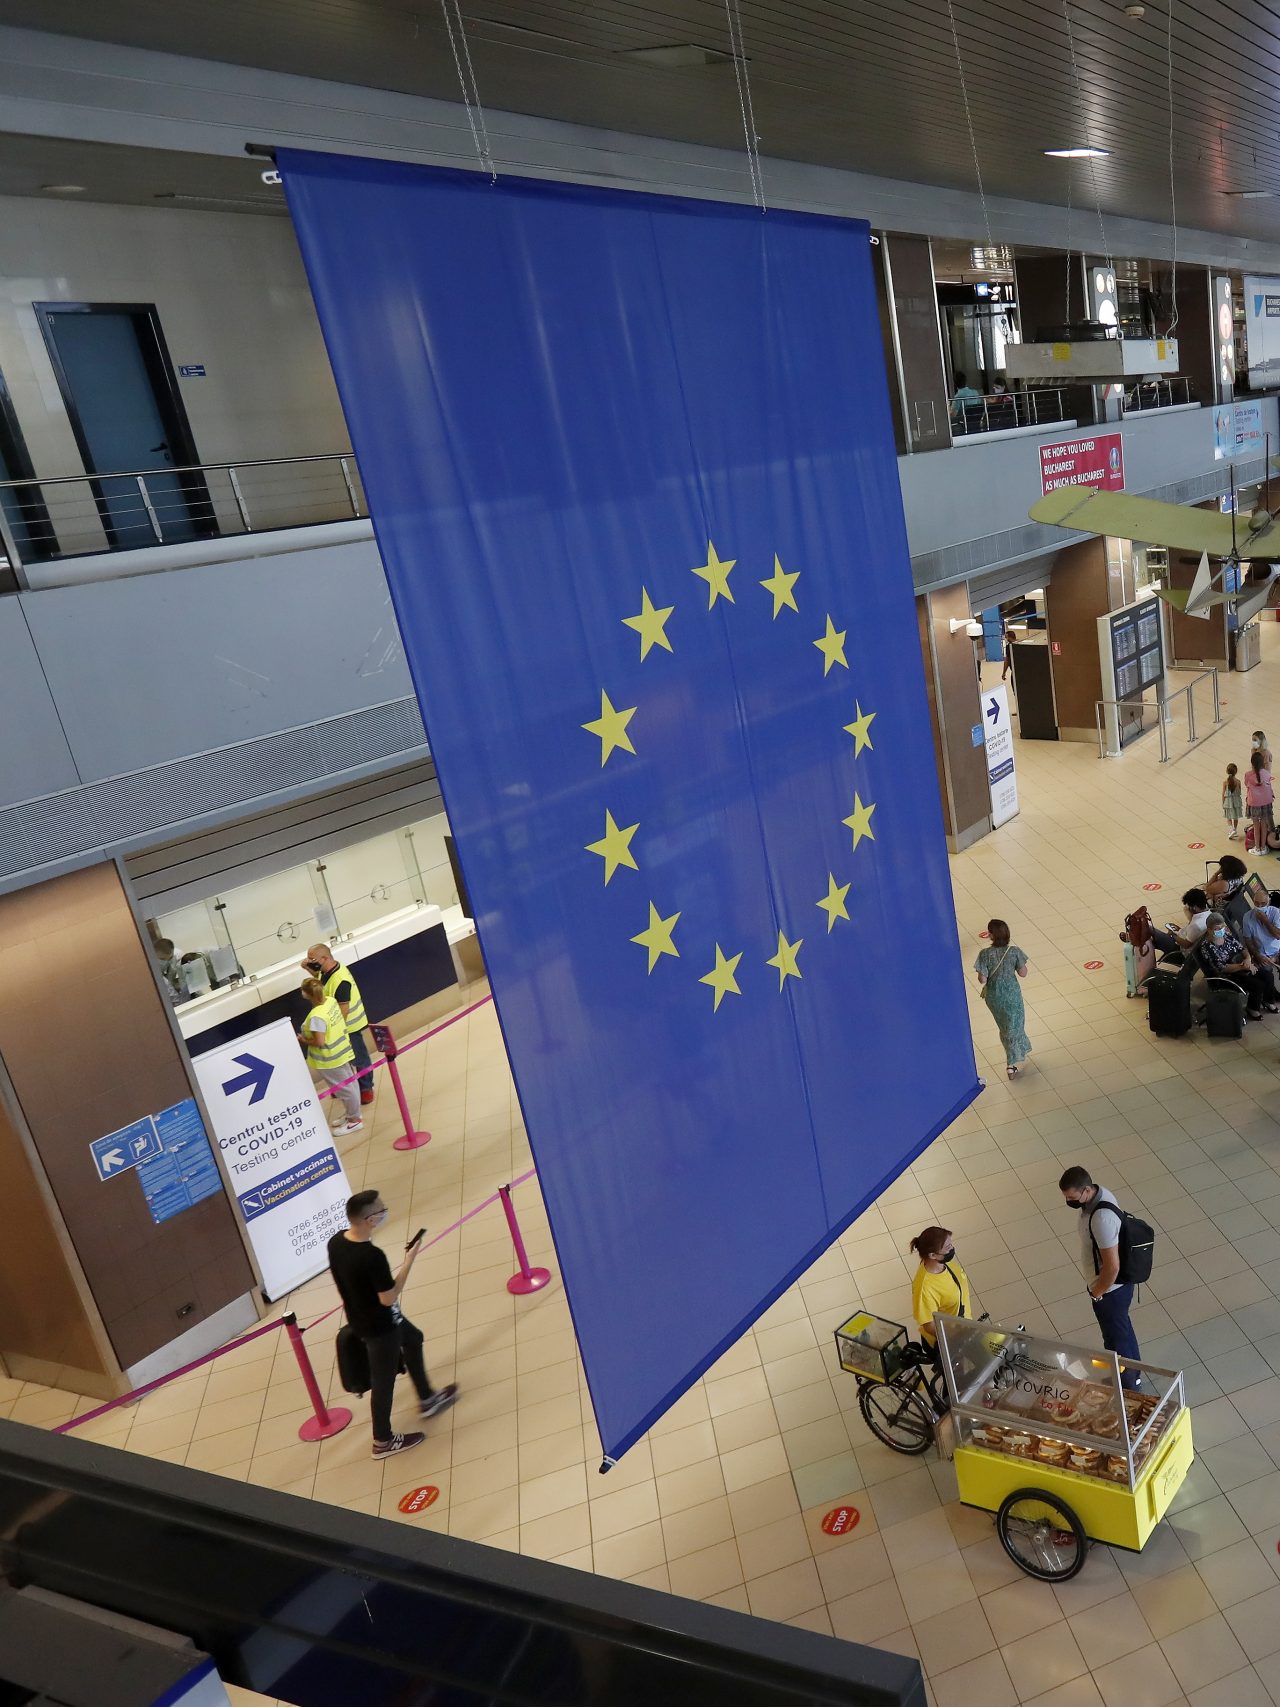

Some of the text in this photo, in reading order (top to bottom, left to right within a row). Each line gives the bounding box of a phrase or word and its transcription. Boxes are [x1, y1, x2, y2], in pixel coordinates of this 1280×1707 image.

[1042, 441, 1095, 459] WE HOPE YOU LOVED
[1044, 460, 1075, 475] BUCHAREST
[1046, 480, 1053, 491] AS
[1053, 476, 1070, 488] MUCH
[1070, 474, 1077, 485] AS
[1078, 469, 1105, 483] BUCHAREST
[219, 1099, 312, 1150] Centru testare
[238, 1116, 303, 1156] COVID-19
[231, 1125, 317, 1175] Testing center
[261, 1153, 334, 1197] Cabinet vaccinare
[264, 1164, 335, 1206] Vaccination centre
[408, 1489, 428, 1510] STOP
[832, 1510, 848, 1532] STOP
